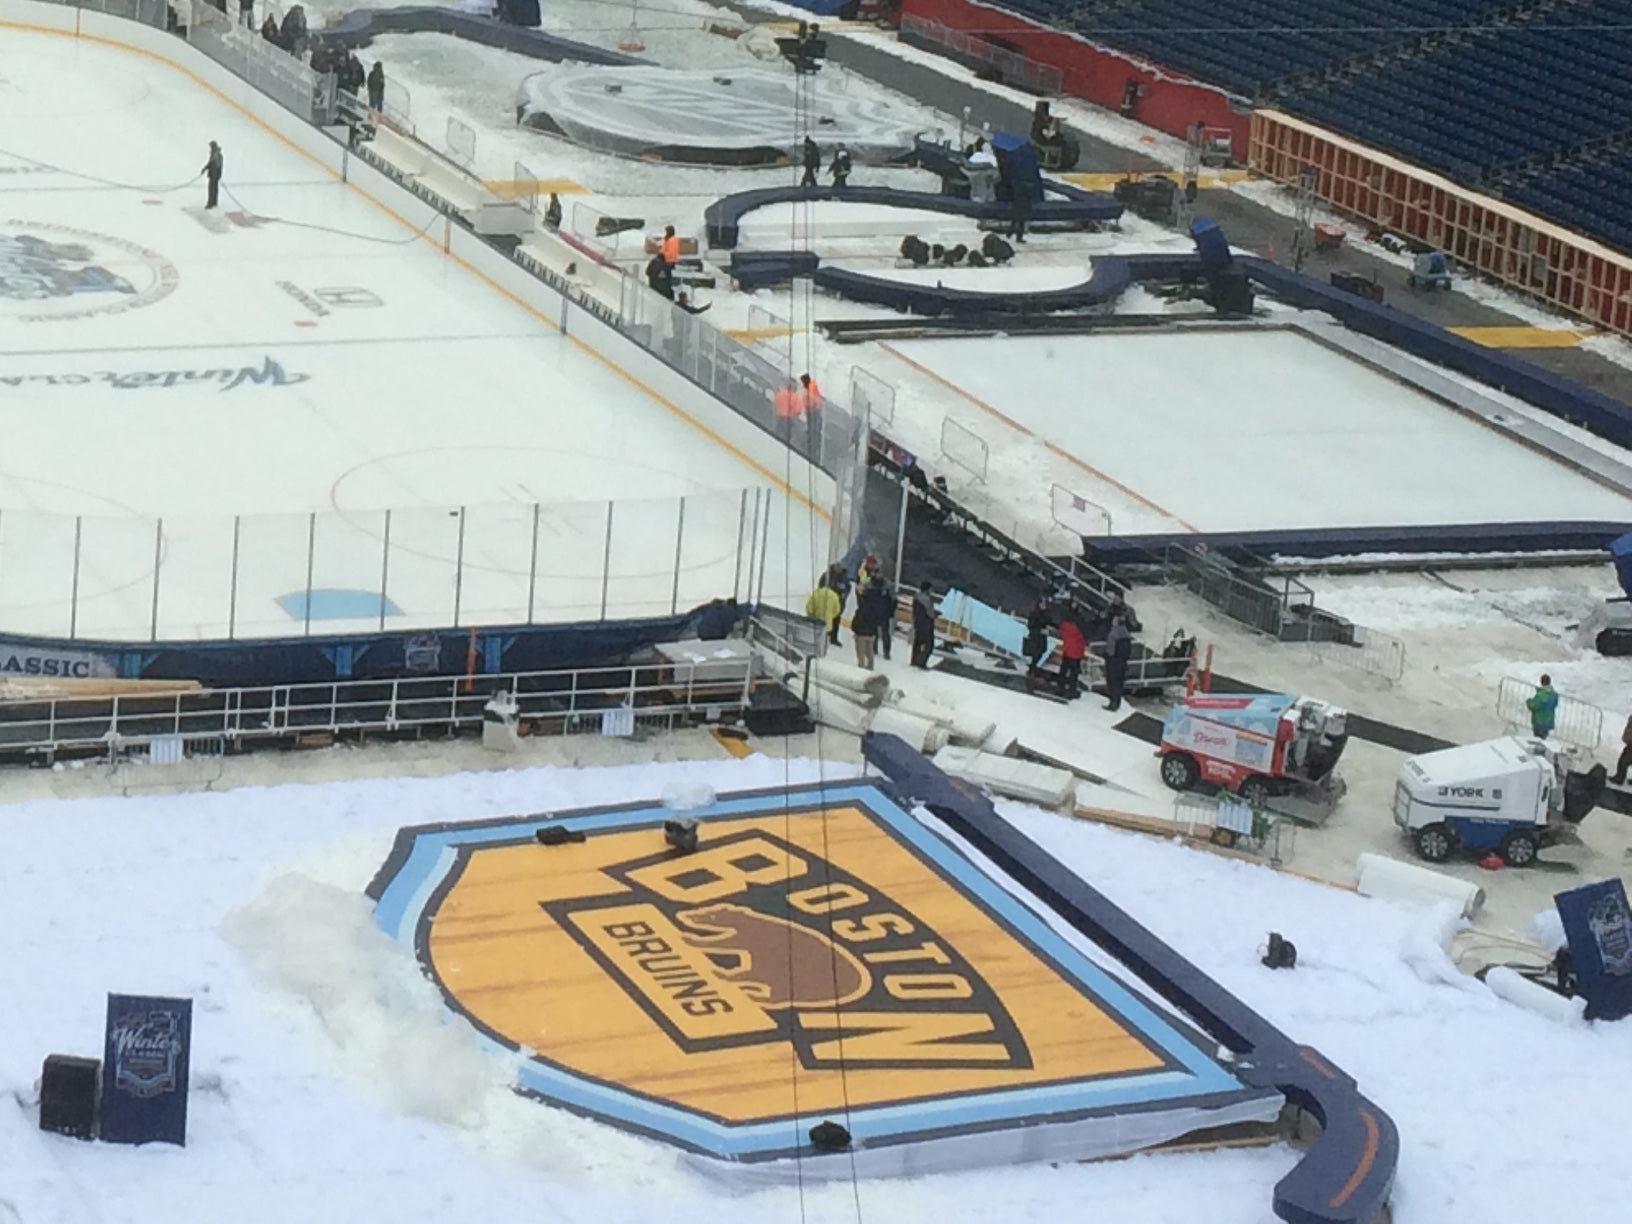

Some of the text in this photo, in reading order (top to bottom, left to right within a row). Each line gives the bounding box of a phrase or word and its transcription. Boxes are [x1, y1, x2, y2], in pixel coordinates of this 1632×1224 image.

[99, 356, 311, 391] Winter
[1450, 787, 1485, 798] YORK
[624, 835, 1012, 1062] BOSTON
[602, 920, 734, 1017] BRUINS
[110, 1022, 182, 1055] Winter
